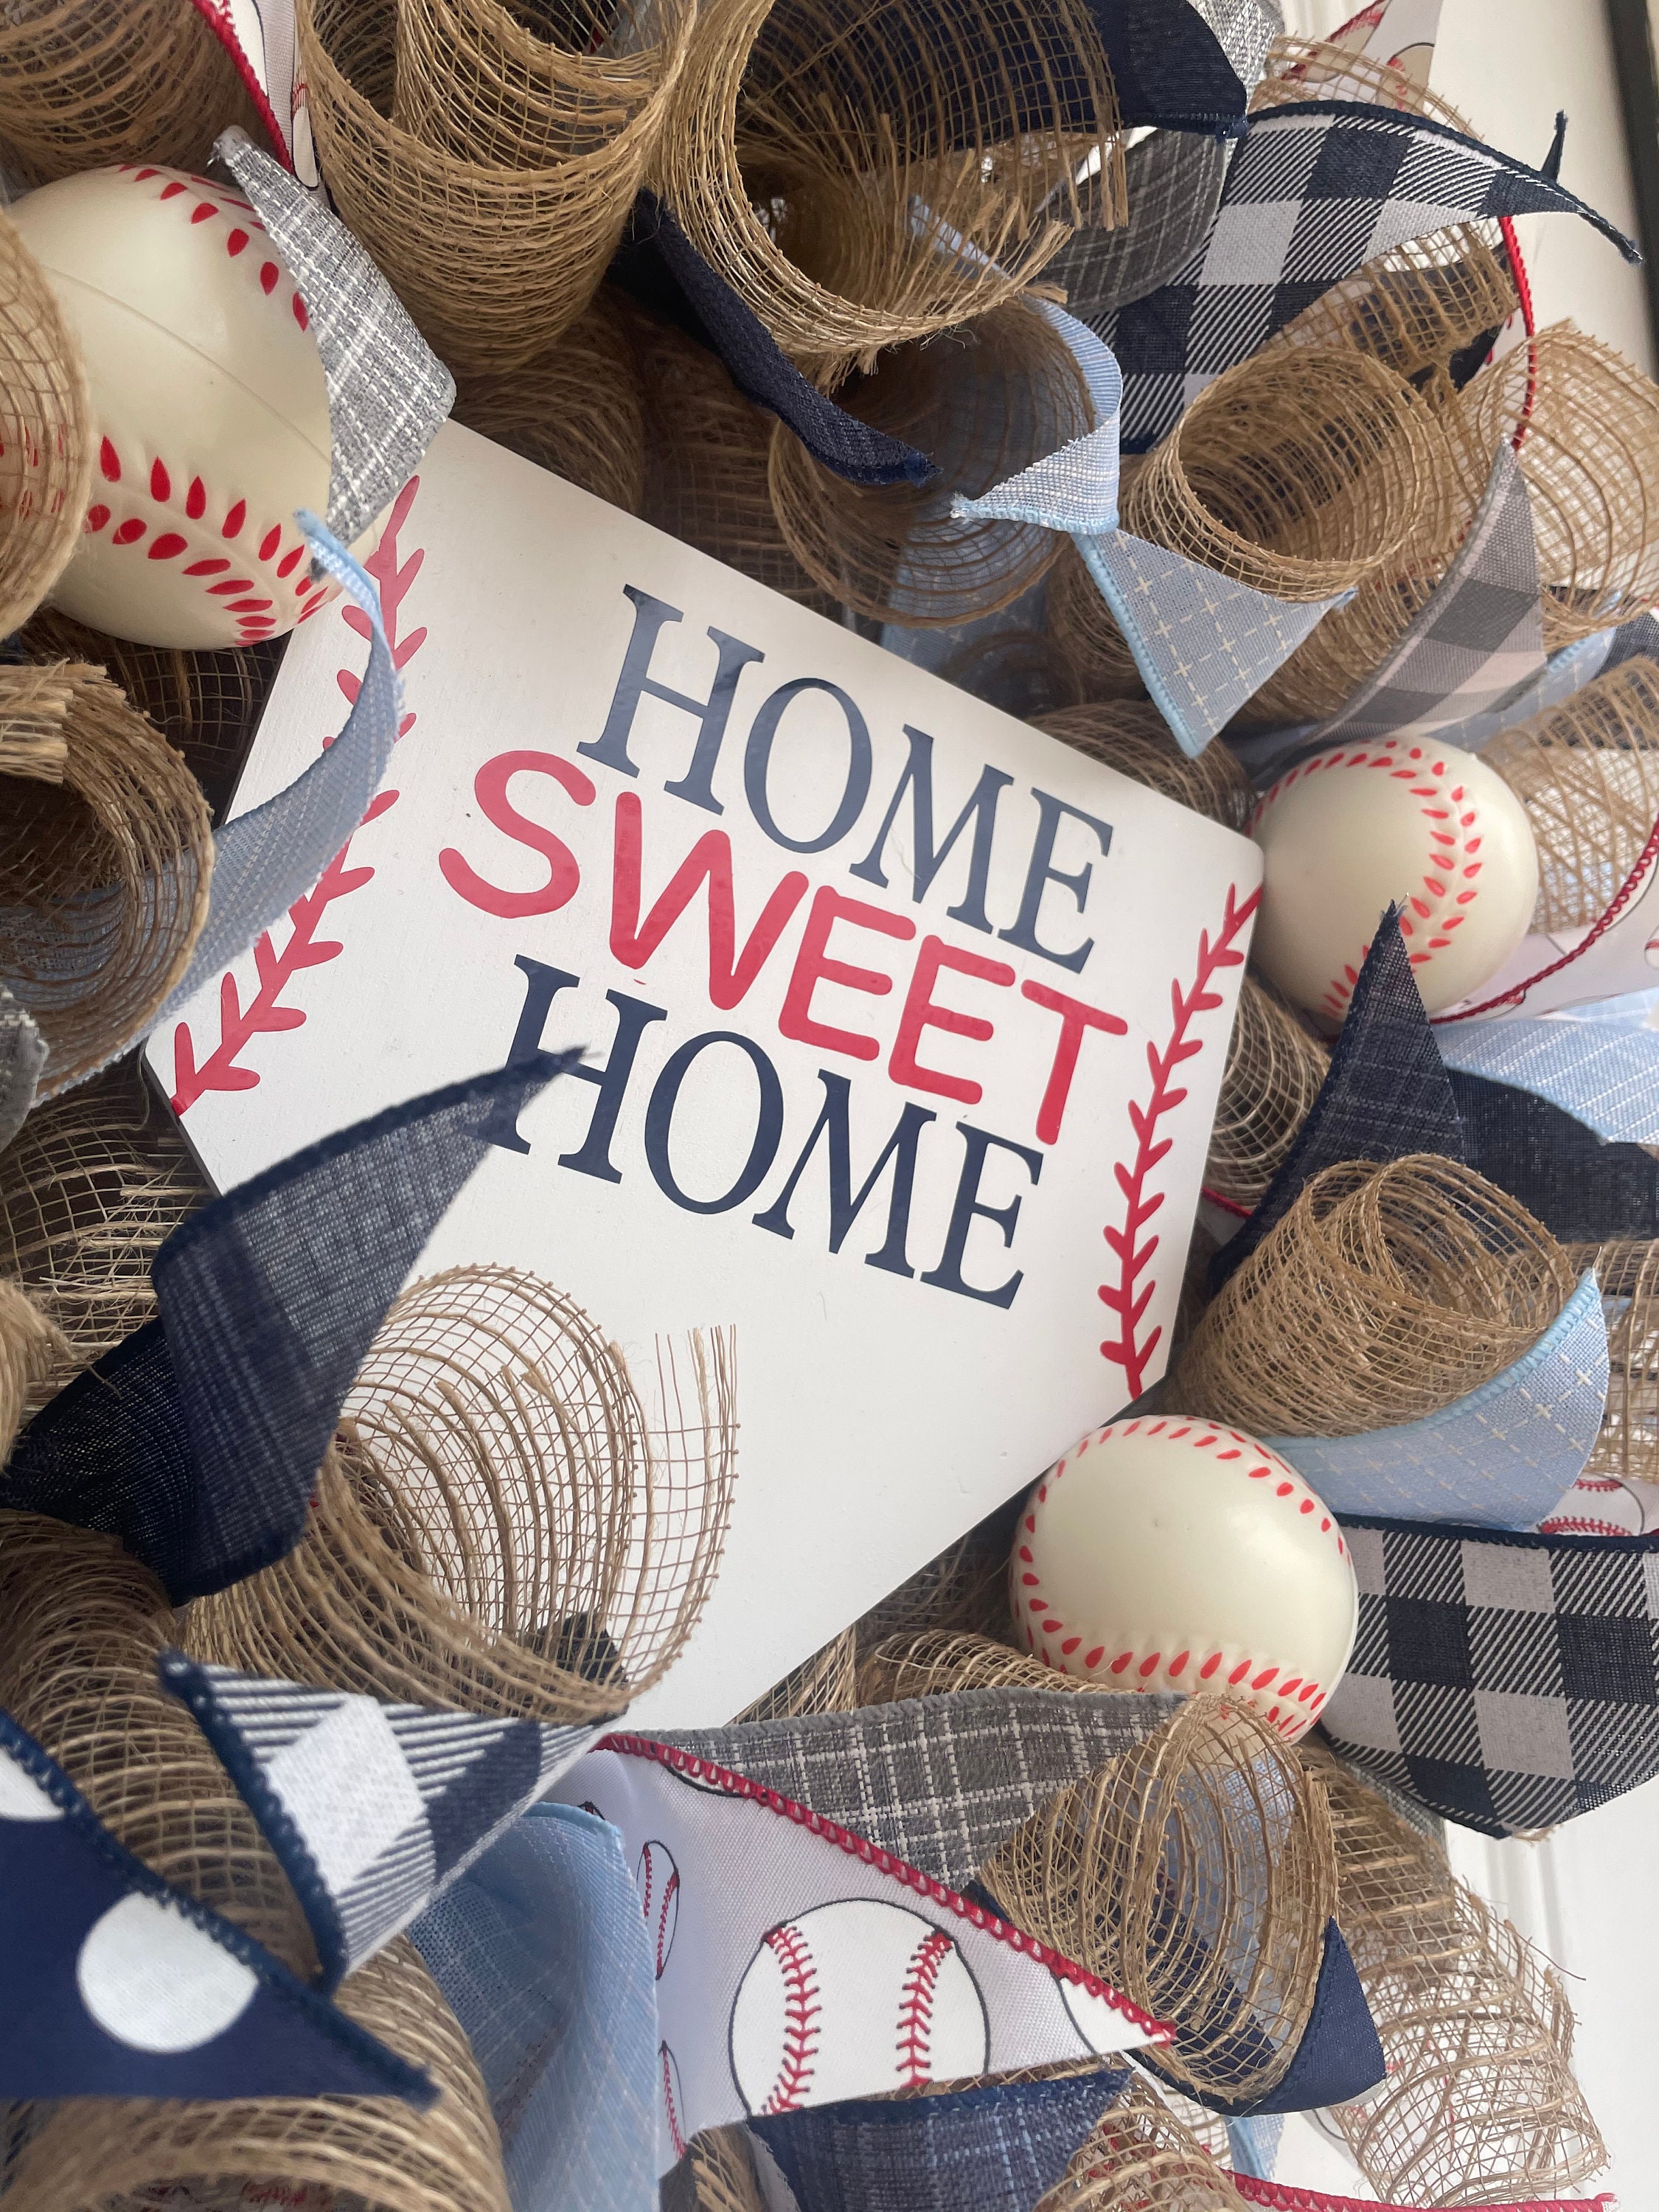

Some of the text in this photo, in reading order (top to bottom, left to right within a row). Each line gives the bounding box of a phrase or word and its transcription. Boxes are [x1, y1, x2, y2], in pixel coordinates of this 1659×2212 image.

[439, 751, 1128, 1145] SWEET
[577, 583, 1113, 974] HOME
[484, 953, 1043, 1310] HOME
